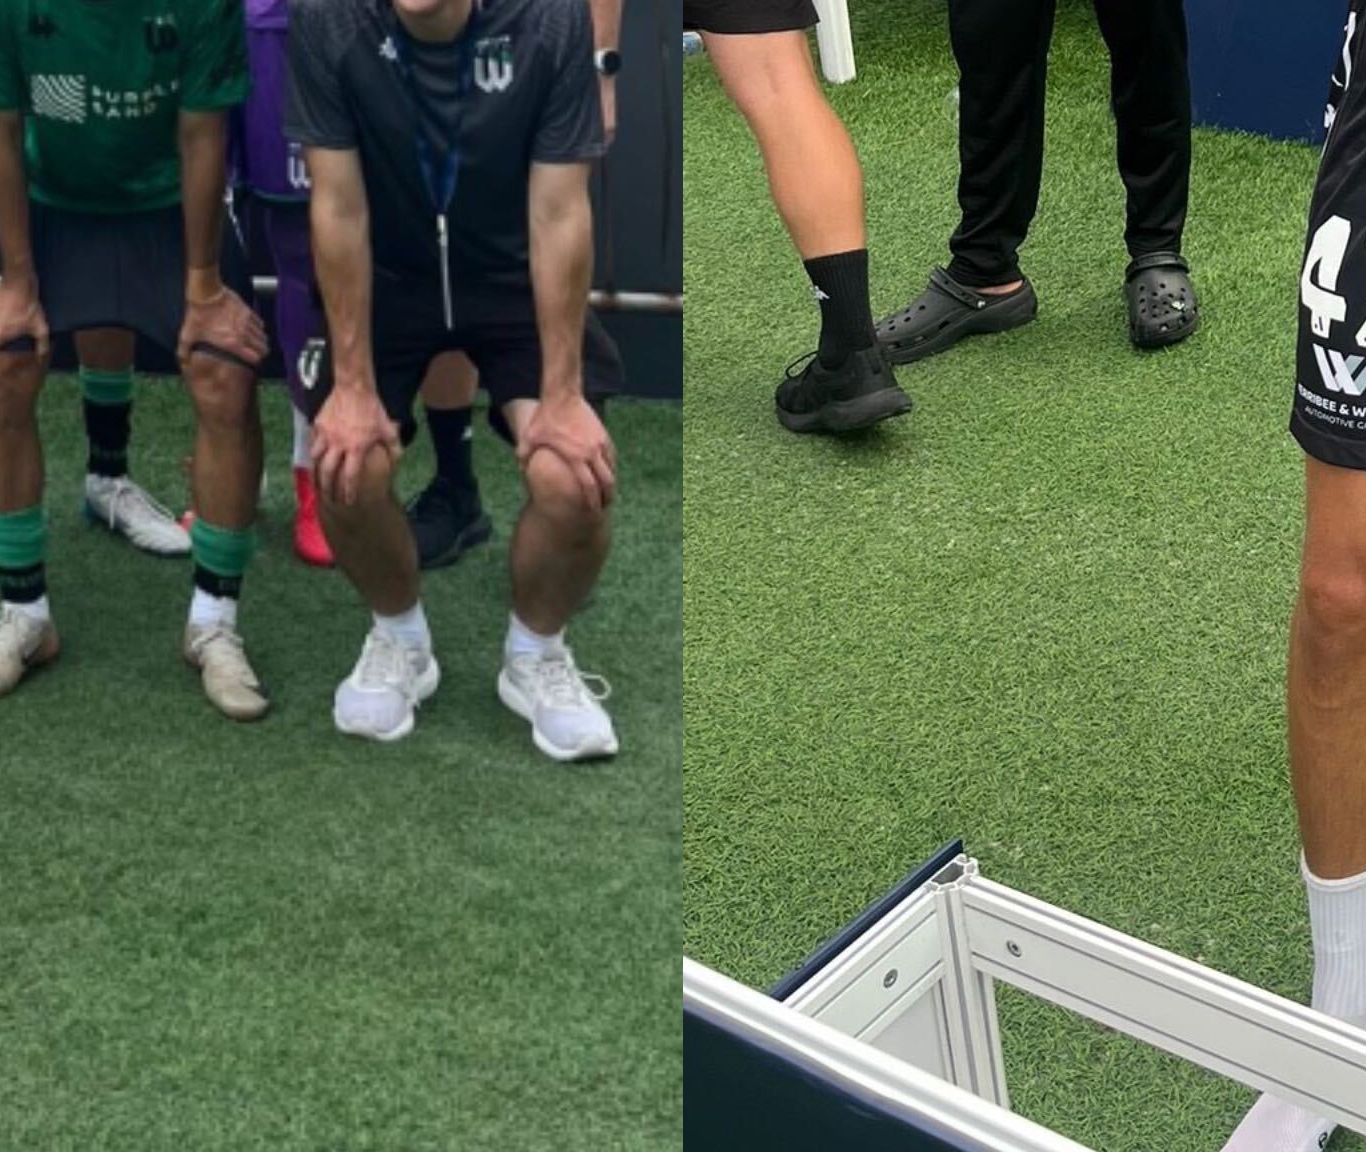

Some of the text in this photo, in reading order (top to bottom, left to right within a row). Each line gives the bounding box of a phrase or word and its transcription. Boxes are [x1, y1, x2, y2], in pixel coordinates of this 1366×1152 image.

[1298, 382, 1337, 412] ERRIBEE
[1339, 404, 1349, 416] &
[1305, 406, 1354, 429] AUTOMOTIVE
